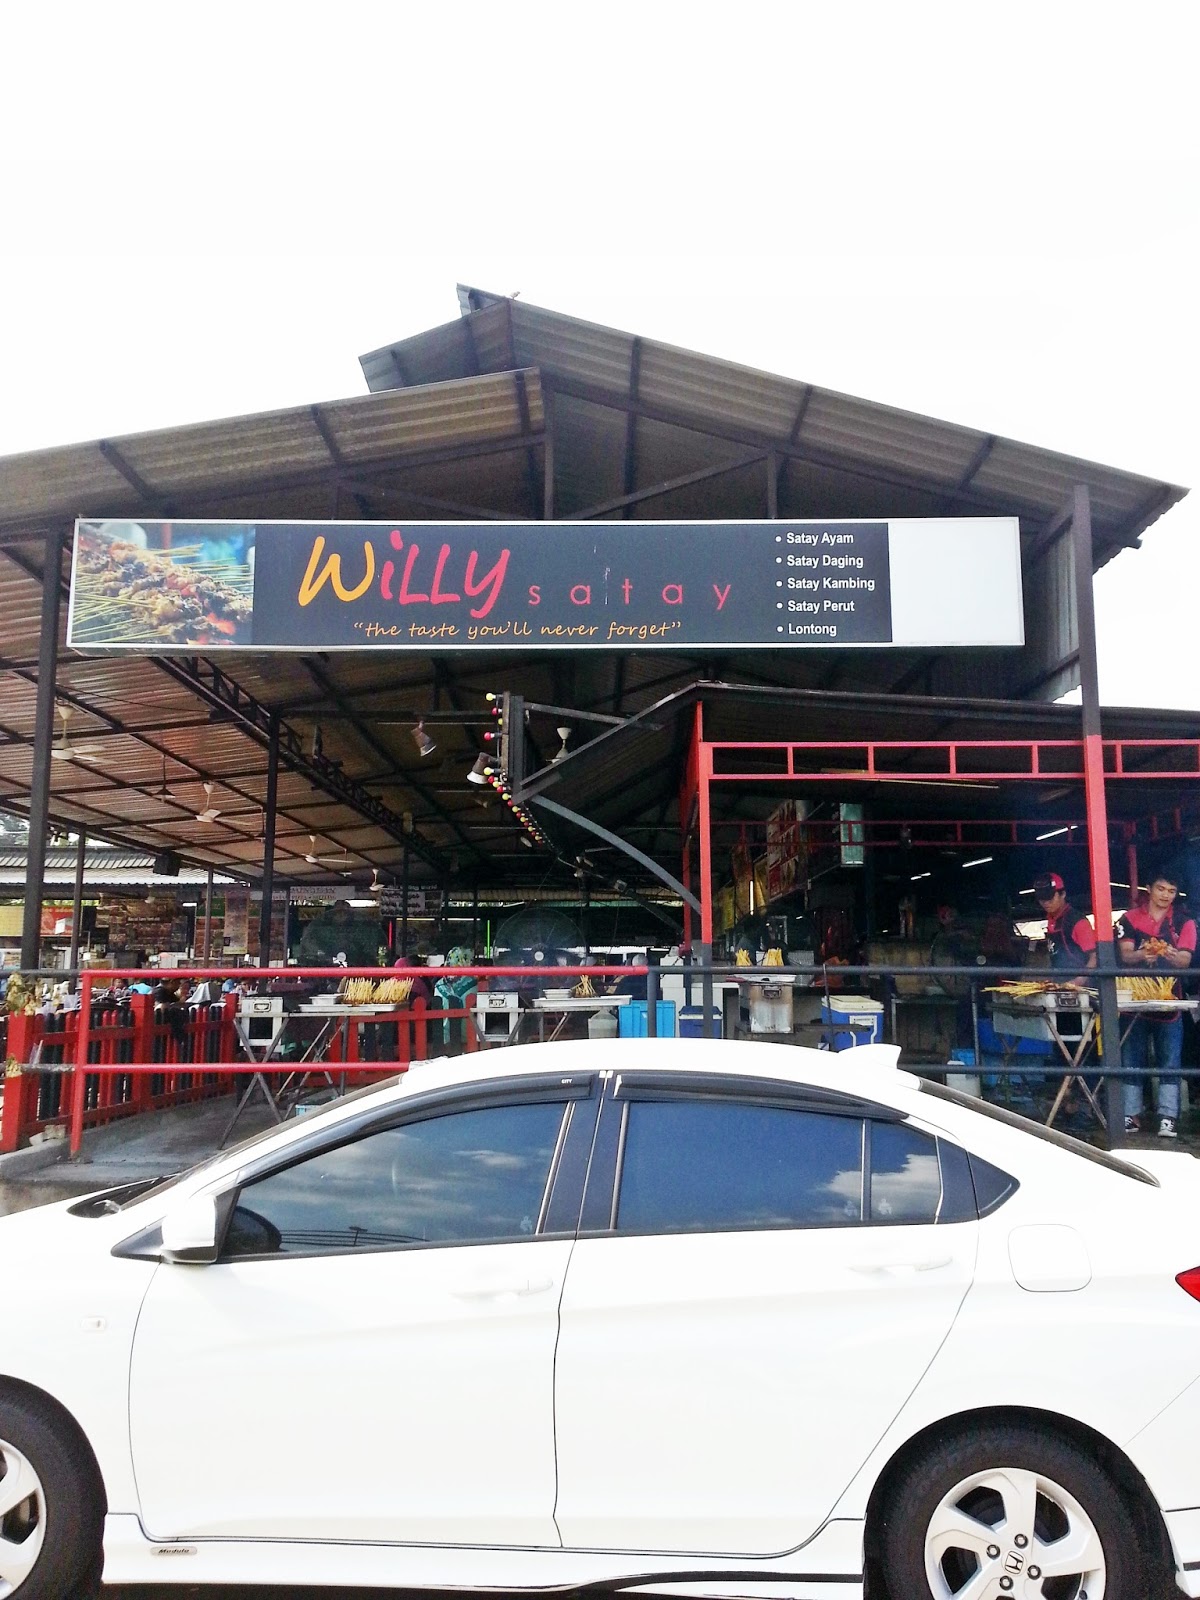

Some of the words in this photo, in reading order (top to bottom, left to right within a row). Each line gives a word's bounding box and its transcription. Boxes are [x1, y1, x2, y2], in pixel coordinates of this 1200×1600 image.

[786, 532, 819, 546] Satay
[821, 532, 854, 546] Ayam
[787, 555, 820, 569] Satay
[822, 555, 864, 568] Daging
[787, 577, 820, 591] Satay
[823, 577, 876, 591] Kambing
[528, 578, 732, 611] satay
[787, 600, 820, 614] Satay
[823, 600, 855, 612] Perut
[408, 622, 460, 637] taste
[541, 625, 599, 637] never
[788, 623, 837, 636] Lontong
